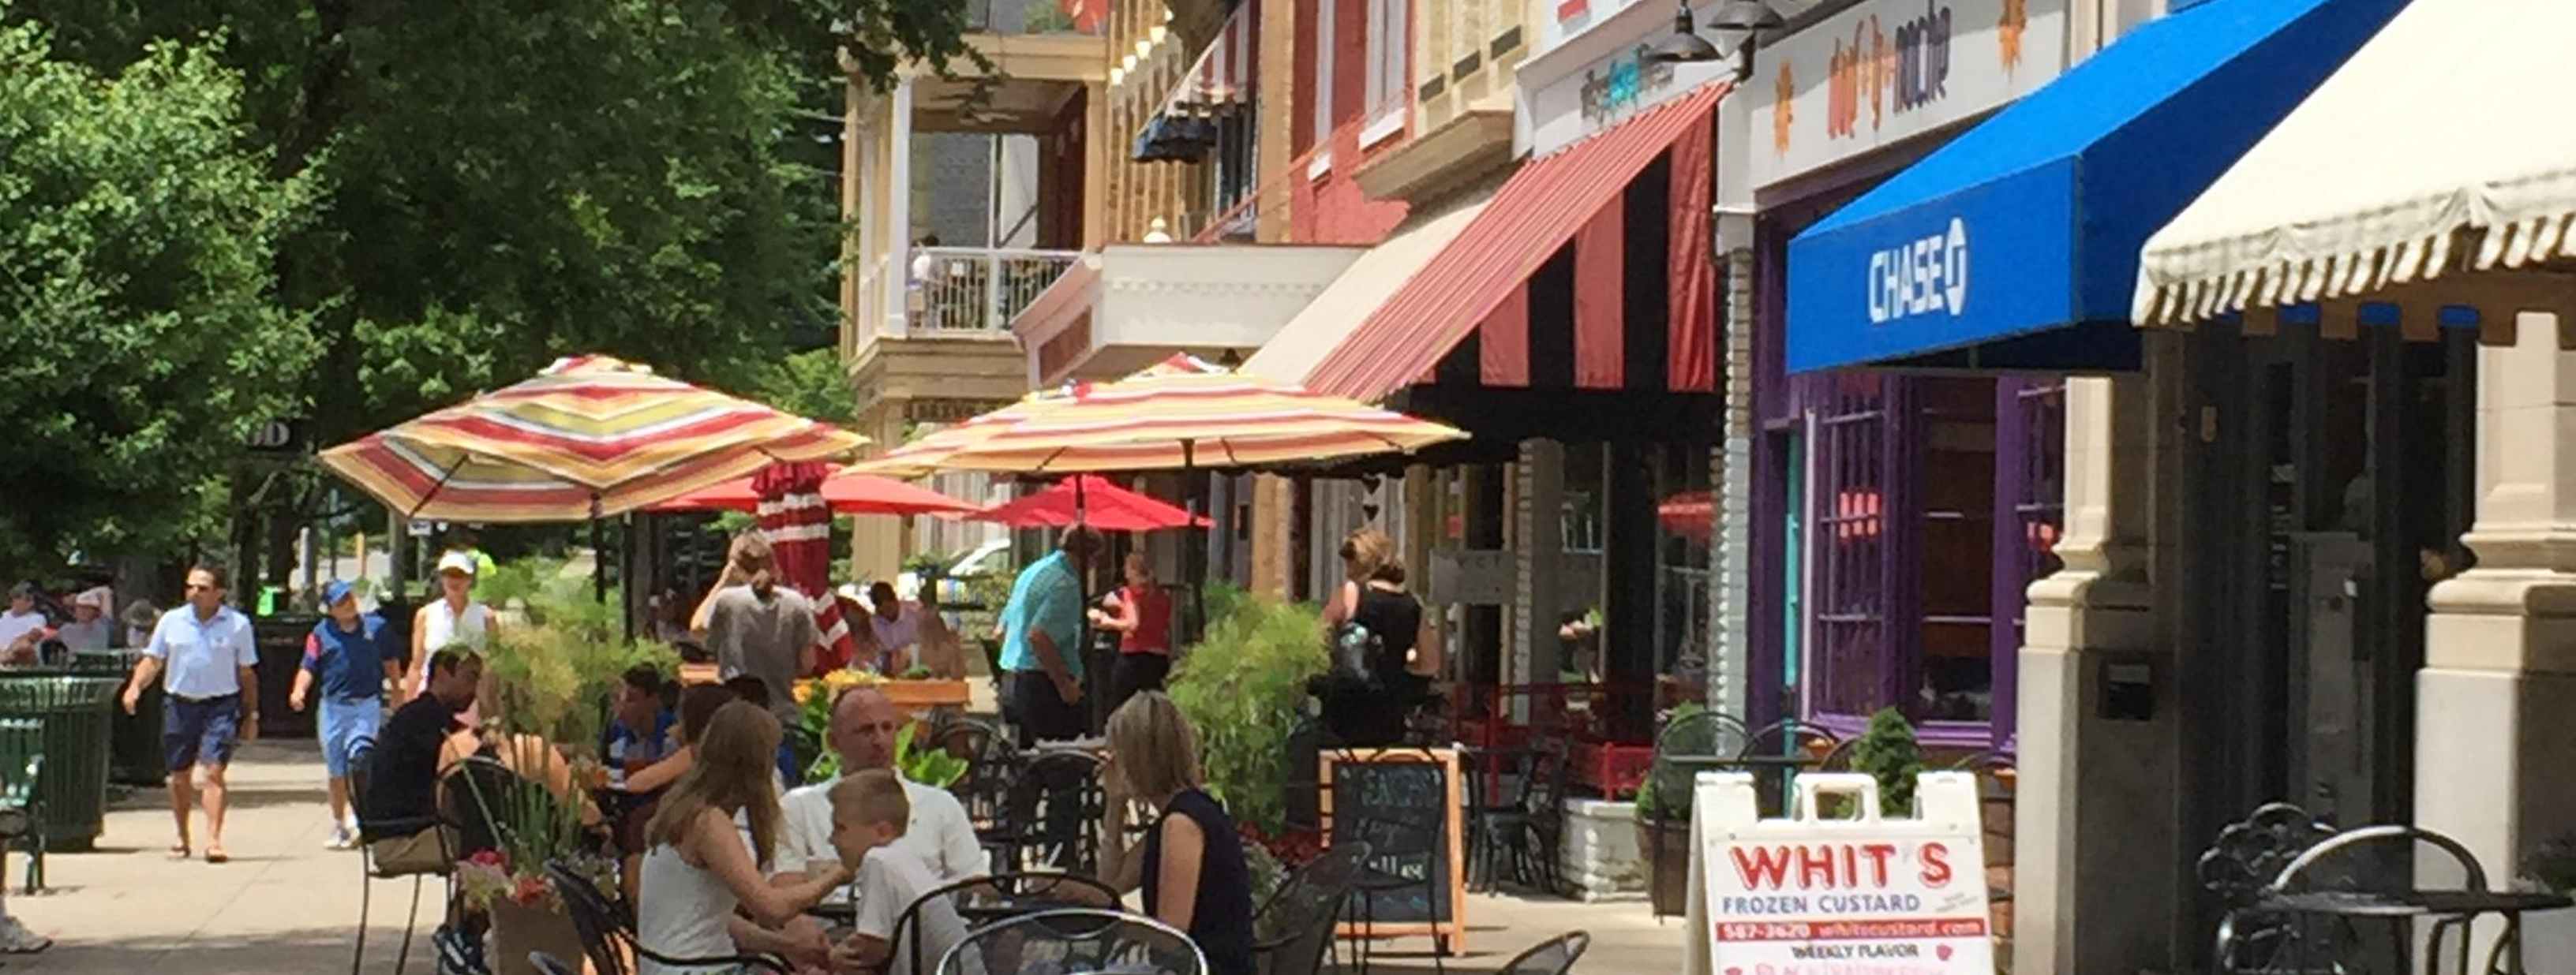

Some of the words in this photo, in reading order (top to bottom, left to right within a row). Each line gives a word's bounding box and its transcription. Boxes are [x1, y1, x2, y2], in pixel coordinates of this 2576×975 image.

[1869, 235, 1944, 323] CHASE
[1723, 896, 1808, 914] FROZEN
[1818, 894, 1921, 913] CUSTARD
[1791, 945, 1854, 960] WEEKLY
[1858, 944, 1919, 958] FLAVOR
